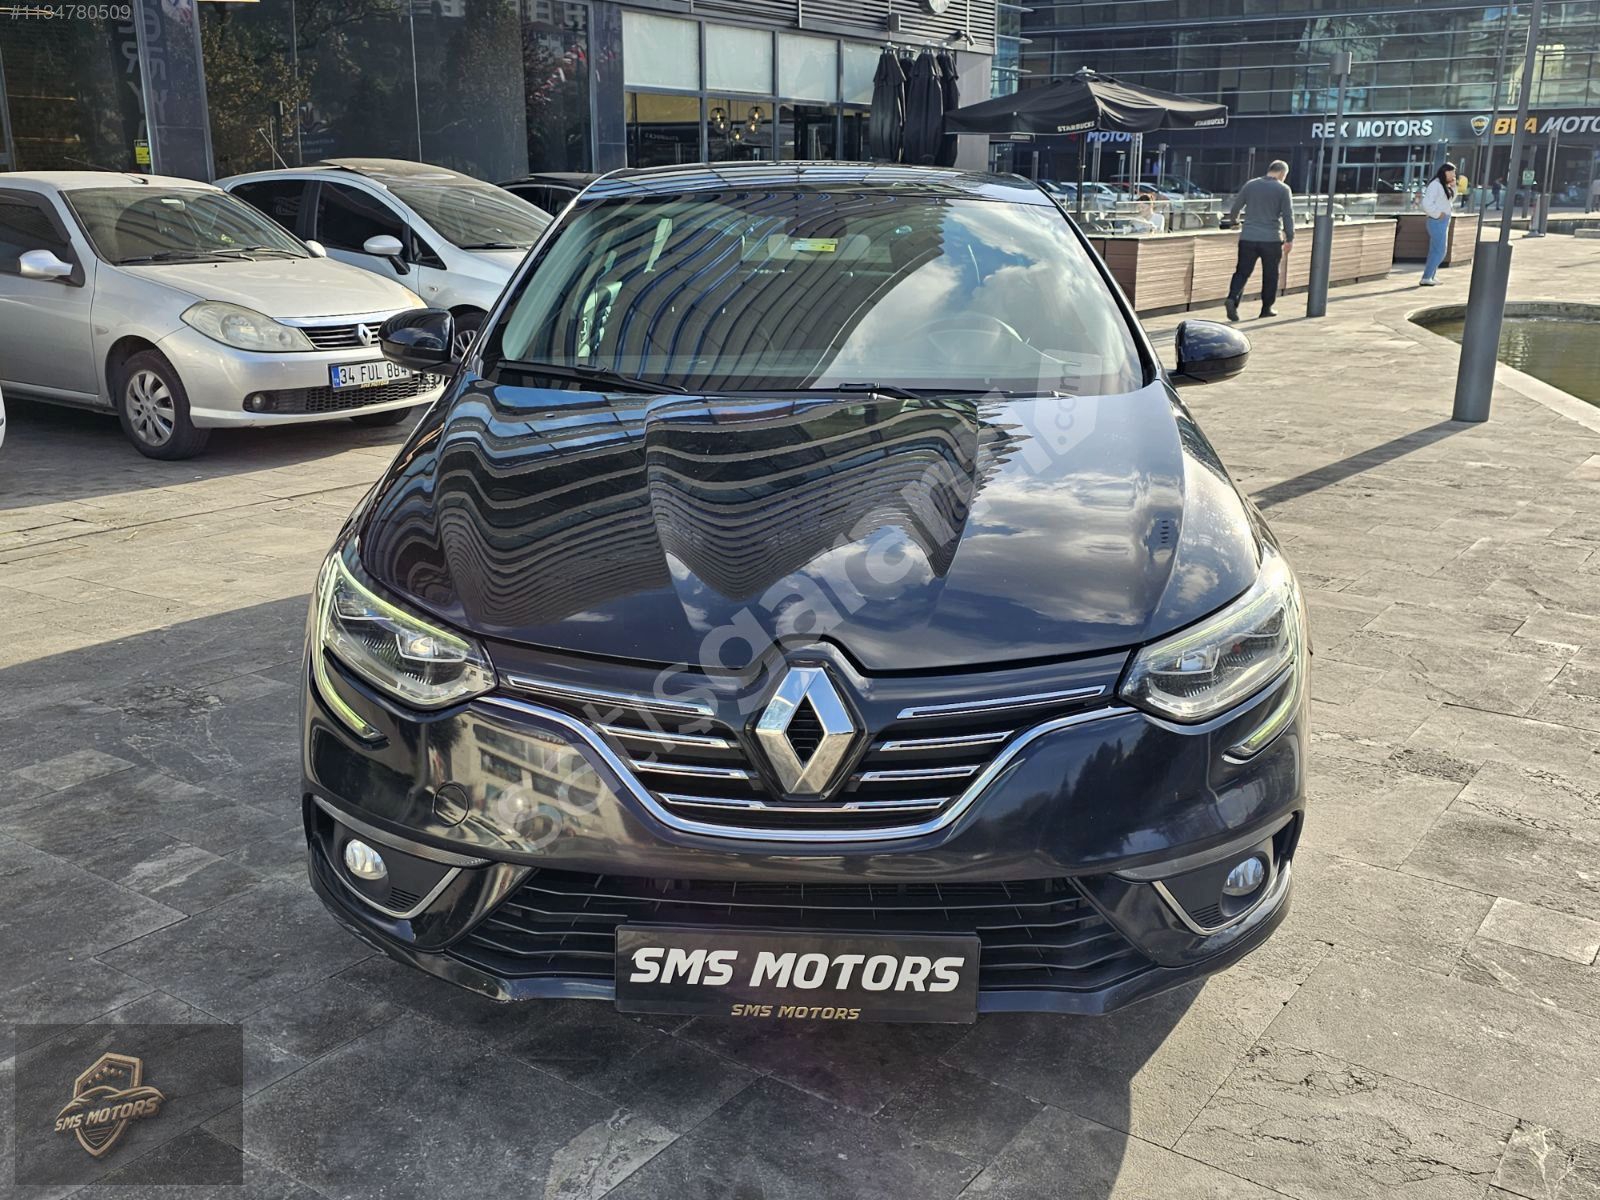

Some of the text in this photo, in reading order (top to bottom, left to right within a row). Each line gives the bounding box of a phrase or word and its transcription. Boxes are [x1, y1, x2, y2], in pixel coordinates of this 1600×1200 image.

[1056, 120, 1095, 132] STARBUCKS
[1311, 119, 1433, 138] REX MOTORS
[1086, 131, 1143, 143] MOTOR
[340, 368, 355, 384] 34
[361, 364, 382, 382] FUL
[629, 947, 965, 992] SMS MOTORS
[730, 1003, 861, 1020] SMS MOTORS
